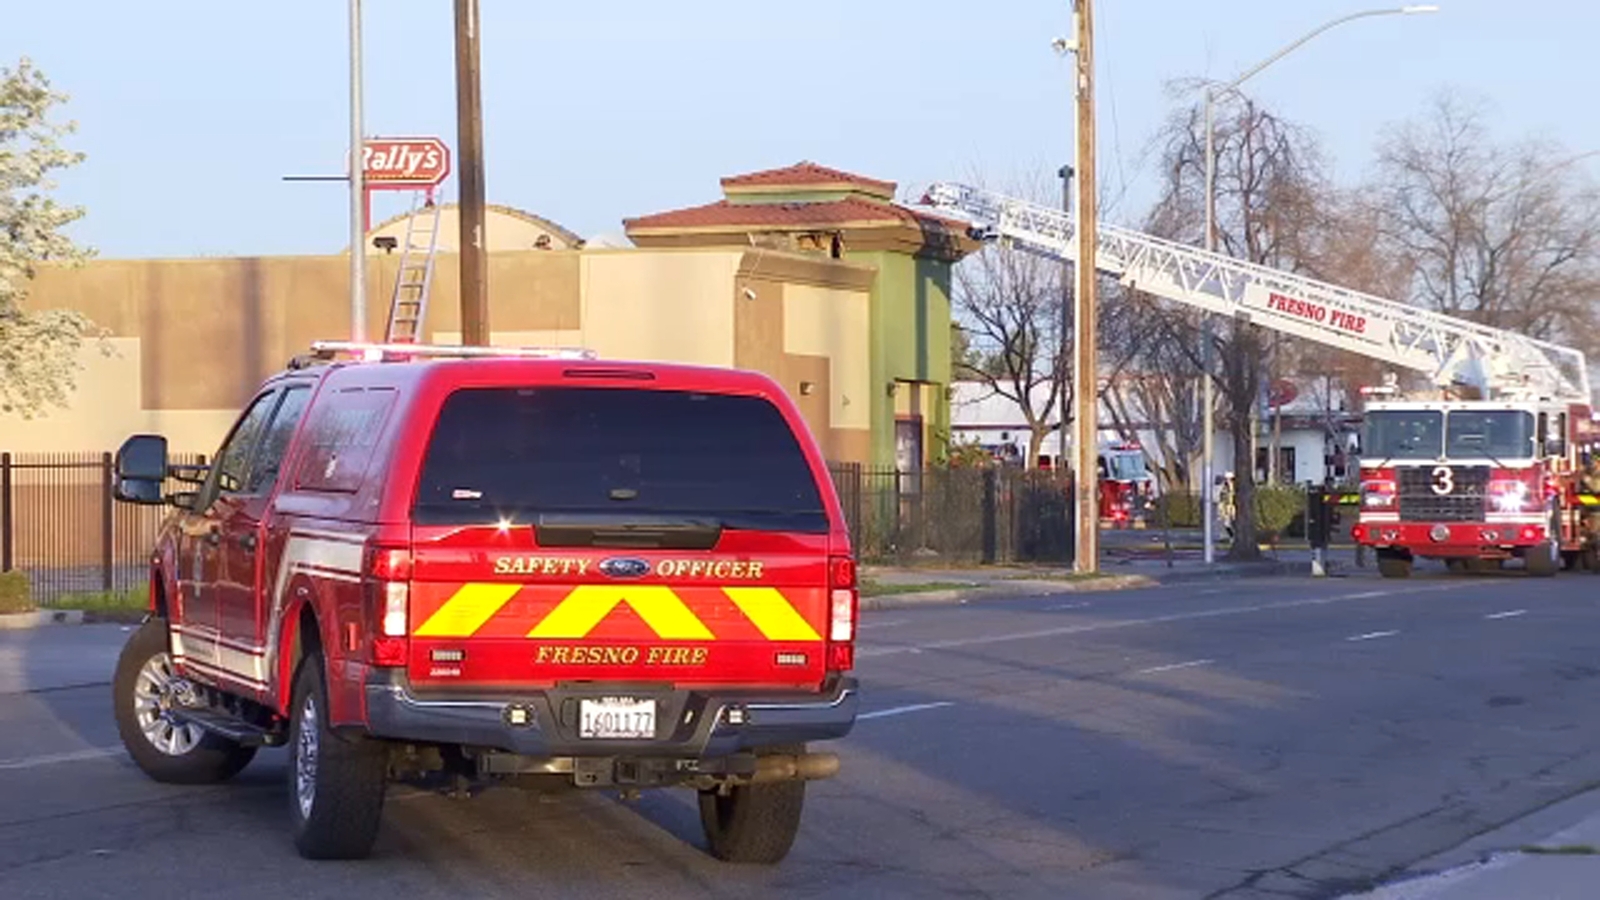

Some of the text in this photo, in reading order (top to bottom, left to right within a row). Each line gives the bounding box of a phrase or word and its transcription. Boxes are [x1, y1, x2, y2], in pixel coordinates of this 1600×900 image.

[1267, 292, 1366, 333] FRESNO FIRE
[1431, 466, 1454, 495] 3
[494, 557, 591, 574] SAFETY
[656, 560, 764, 578] OFFICER
[535, 646, 708, 664] FRESNO FIRE
[584, 711, 653, 733] 1601177
